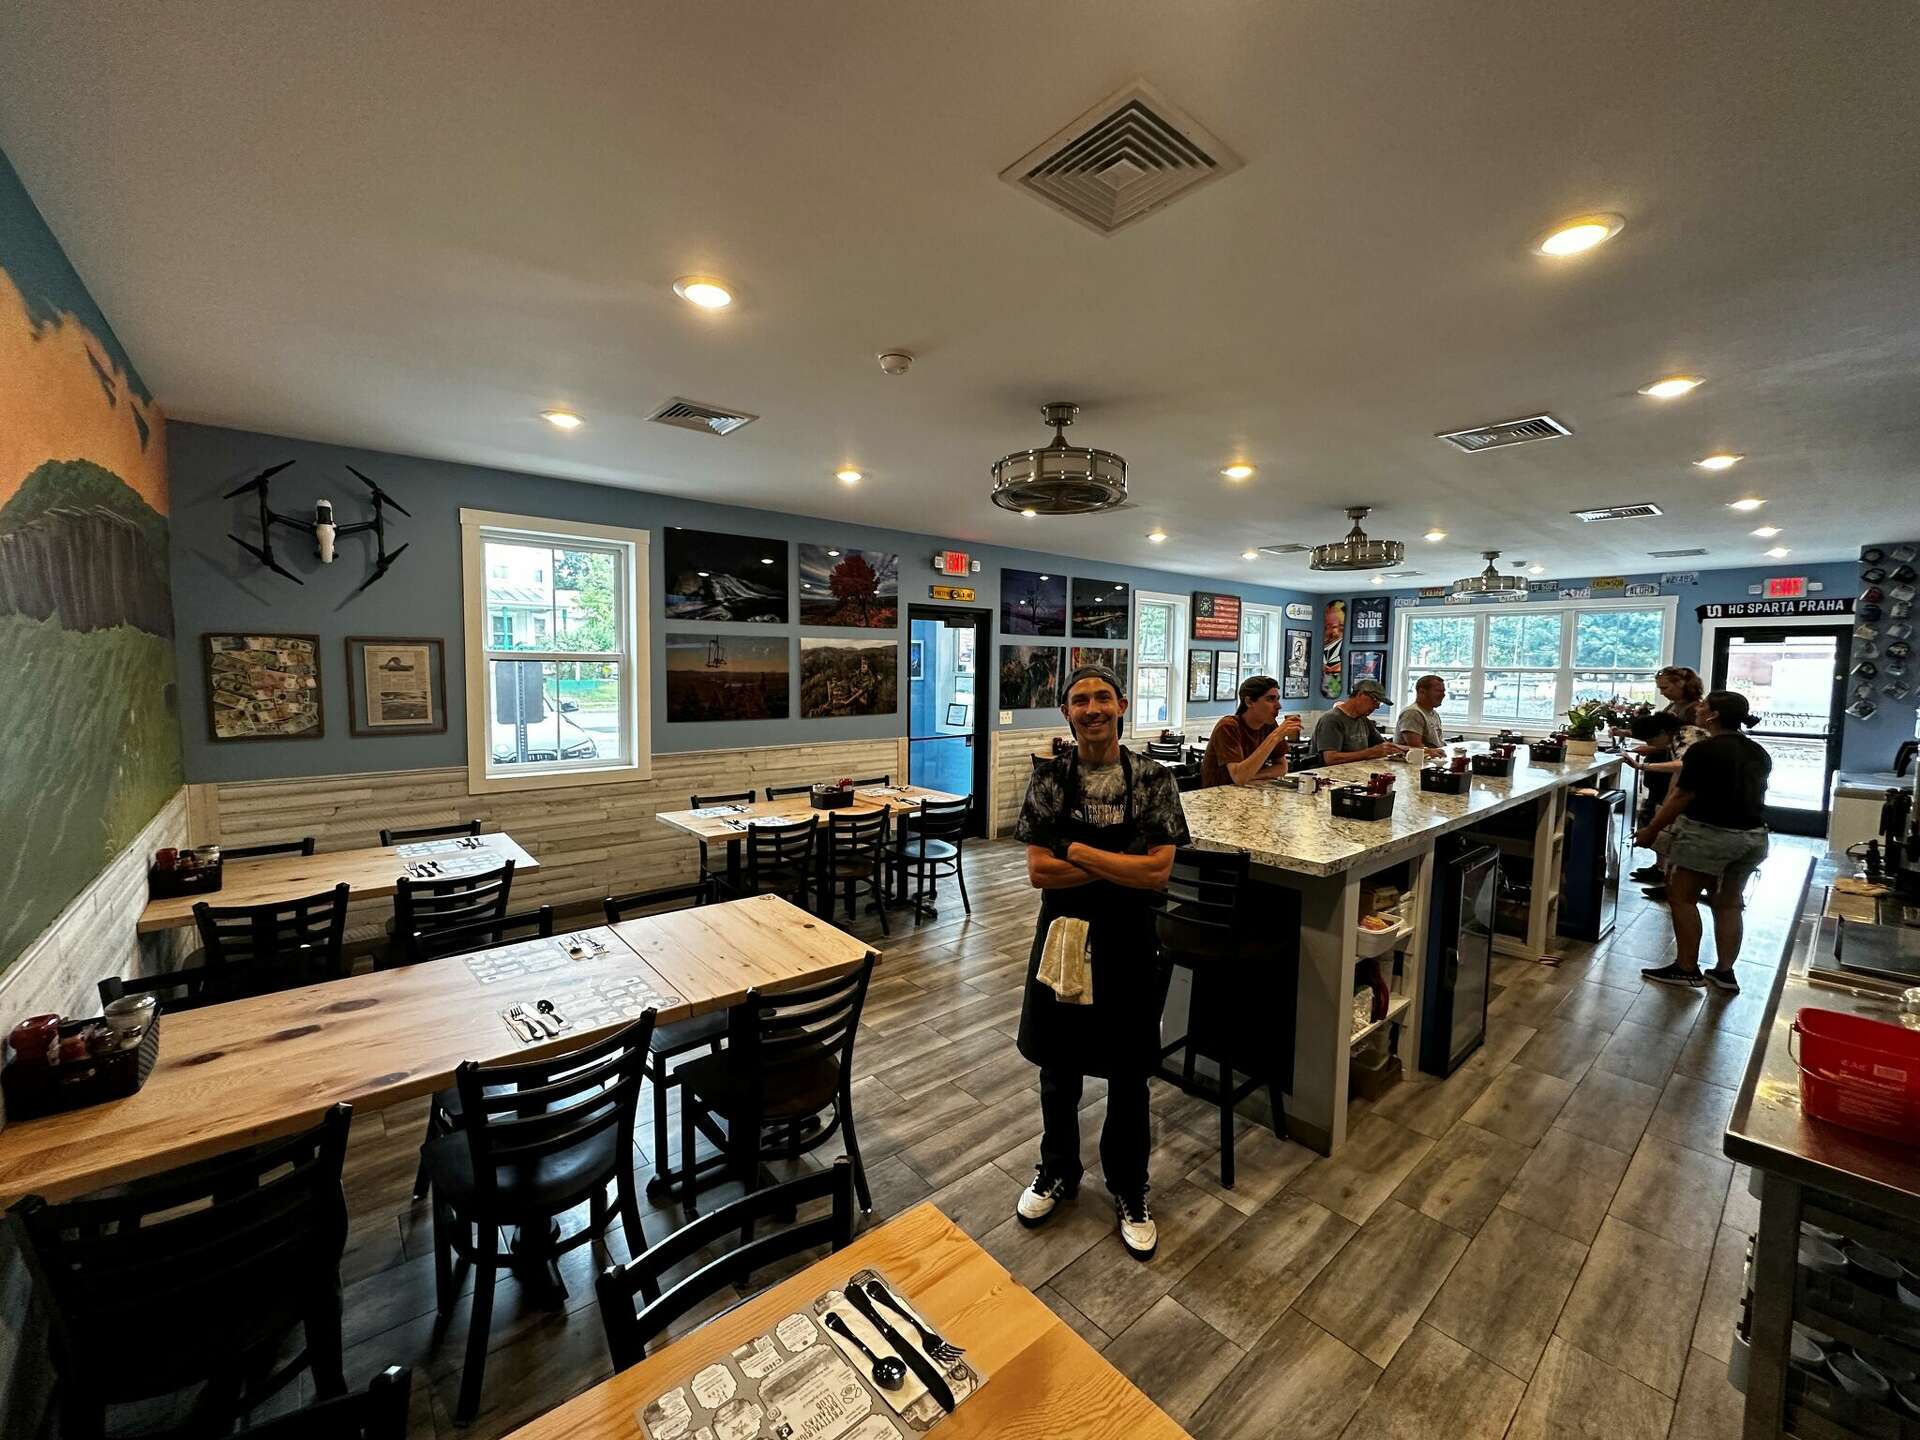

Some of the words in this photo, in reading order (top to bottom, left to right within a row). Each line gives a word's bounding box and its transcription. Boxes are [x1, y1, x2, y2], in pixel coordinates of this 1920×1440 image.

[1728, 604, 1744, 615] HC
[1747, 602, 1794, 614] SPARTA
[1799, 600, 1844, 612] PRAHA
[1357, 619, 1383, 629] SIDE
[1773, 720, 1807, 728] ONLY
